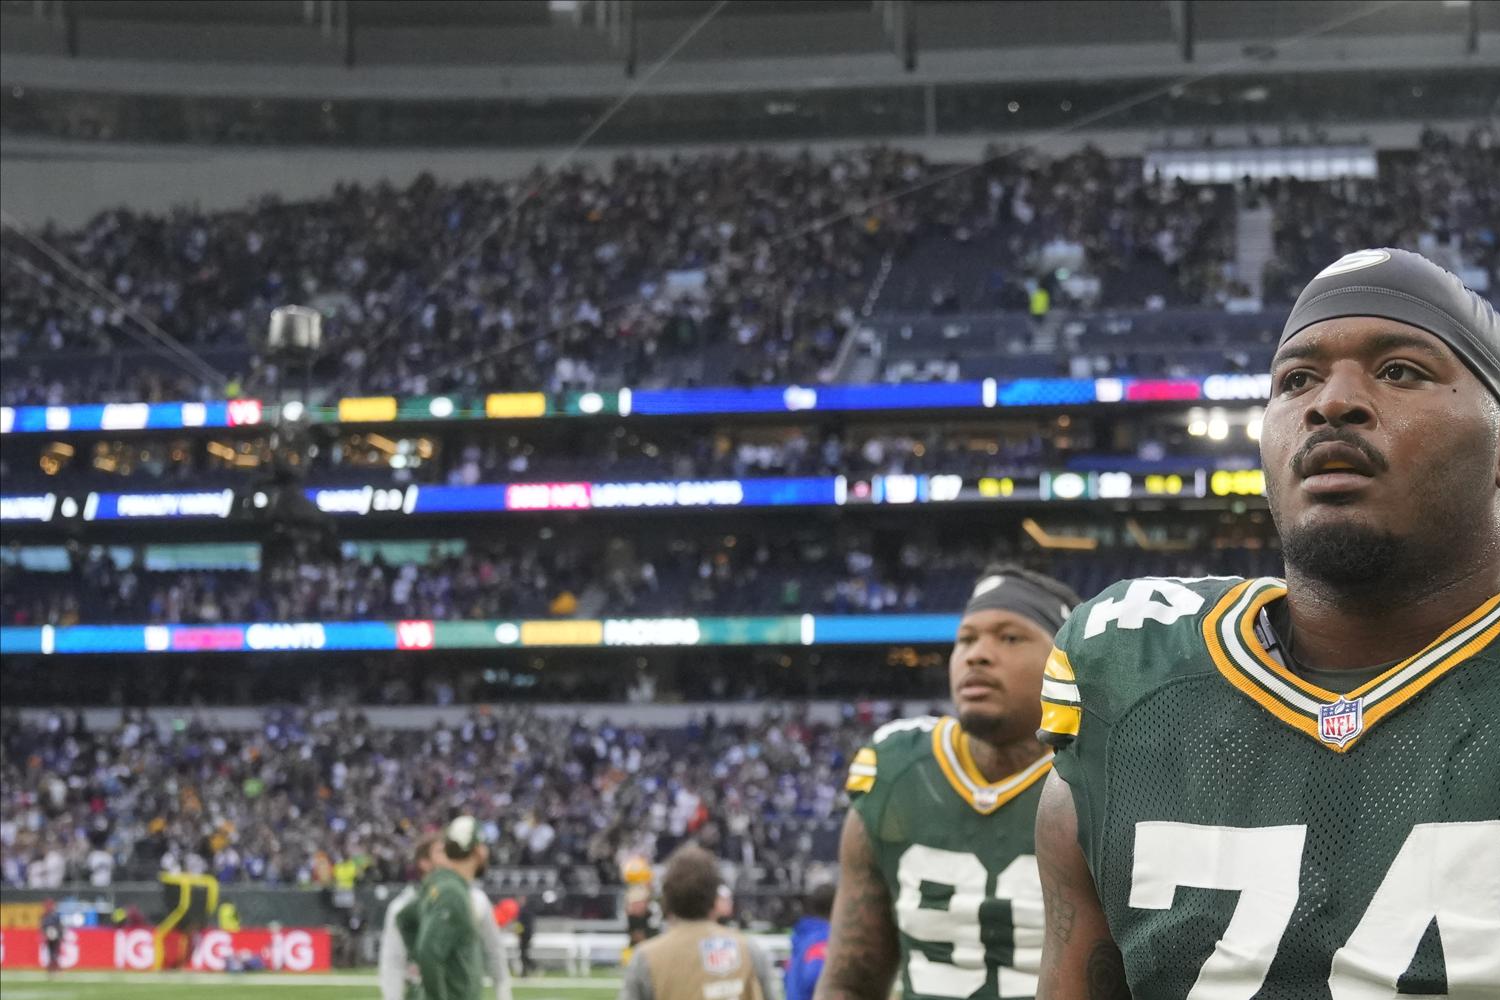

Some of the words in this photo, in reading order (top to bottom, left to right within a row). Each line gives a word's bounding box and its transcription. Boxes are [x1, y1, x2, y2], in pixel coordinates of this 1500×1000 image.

[1203, 374, 1272, 400] GIANT
[399, 621, 433, 647] VS
[1324, 714, 1356, 737] NFL
[896, 843, 1046, 1000] 91
[113, 930, 155, 968] IG
[271, 930, 314, 969] IG
